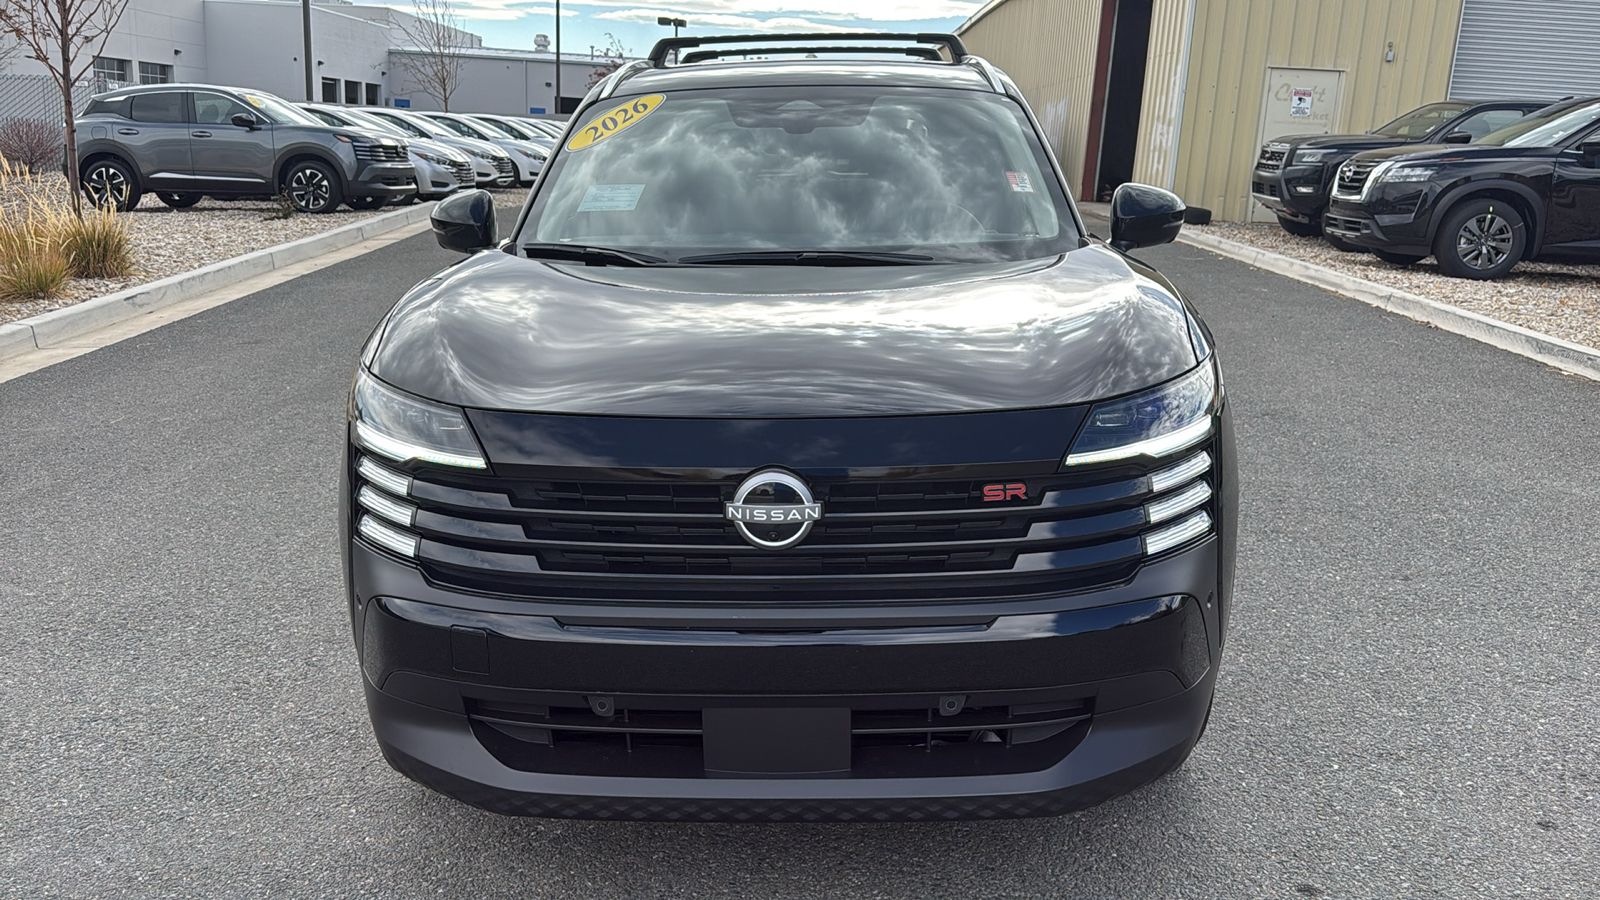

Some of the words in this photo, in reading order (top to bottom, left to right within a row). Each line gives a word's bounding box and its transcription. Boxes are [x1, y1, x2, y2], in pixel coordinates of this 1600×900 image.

[585, 98, 648, 143] 2026
[983, 483, 1028, 502] SR
[728, 506, 819, 521] NISSAN
